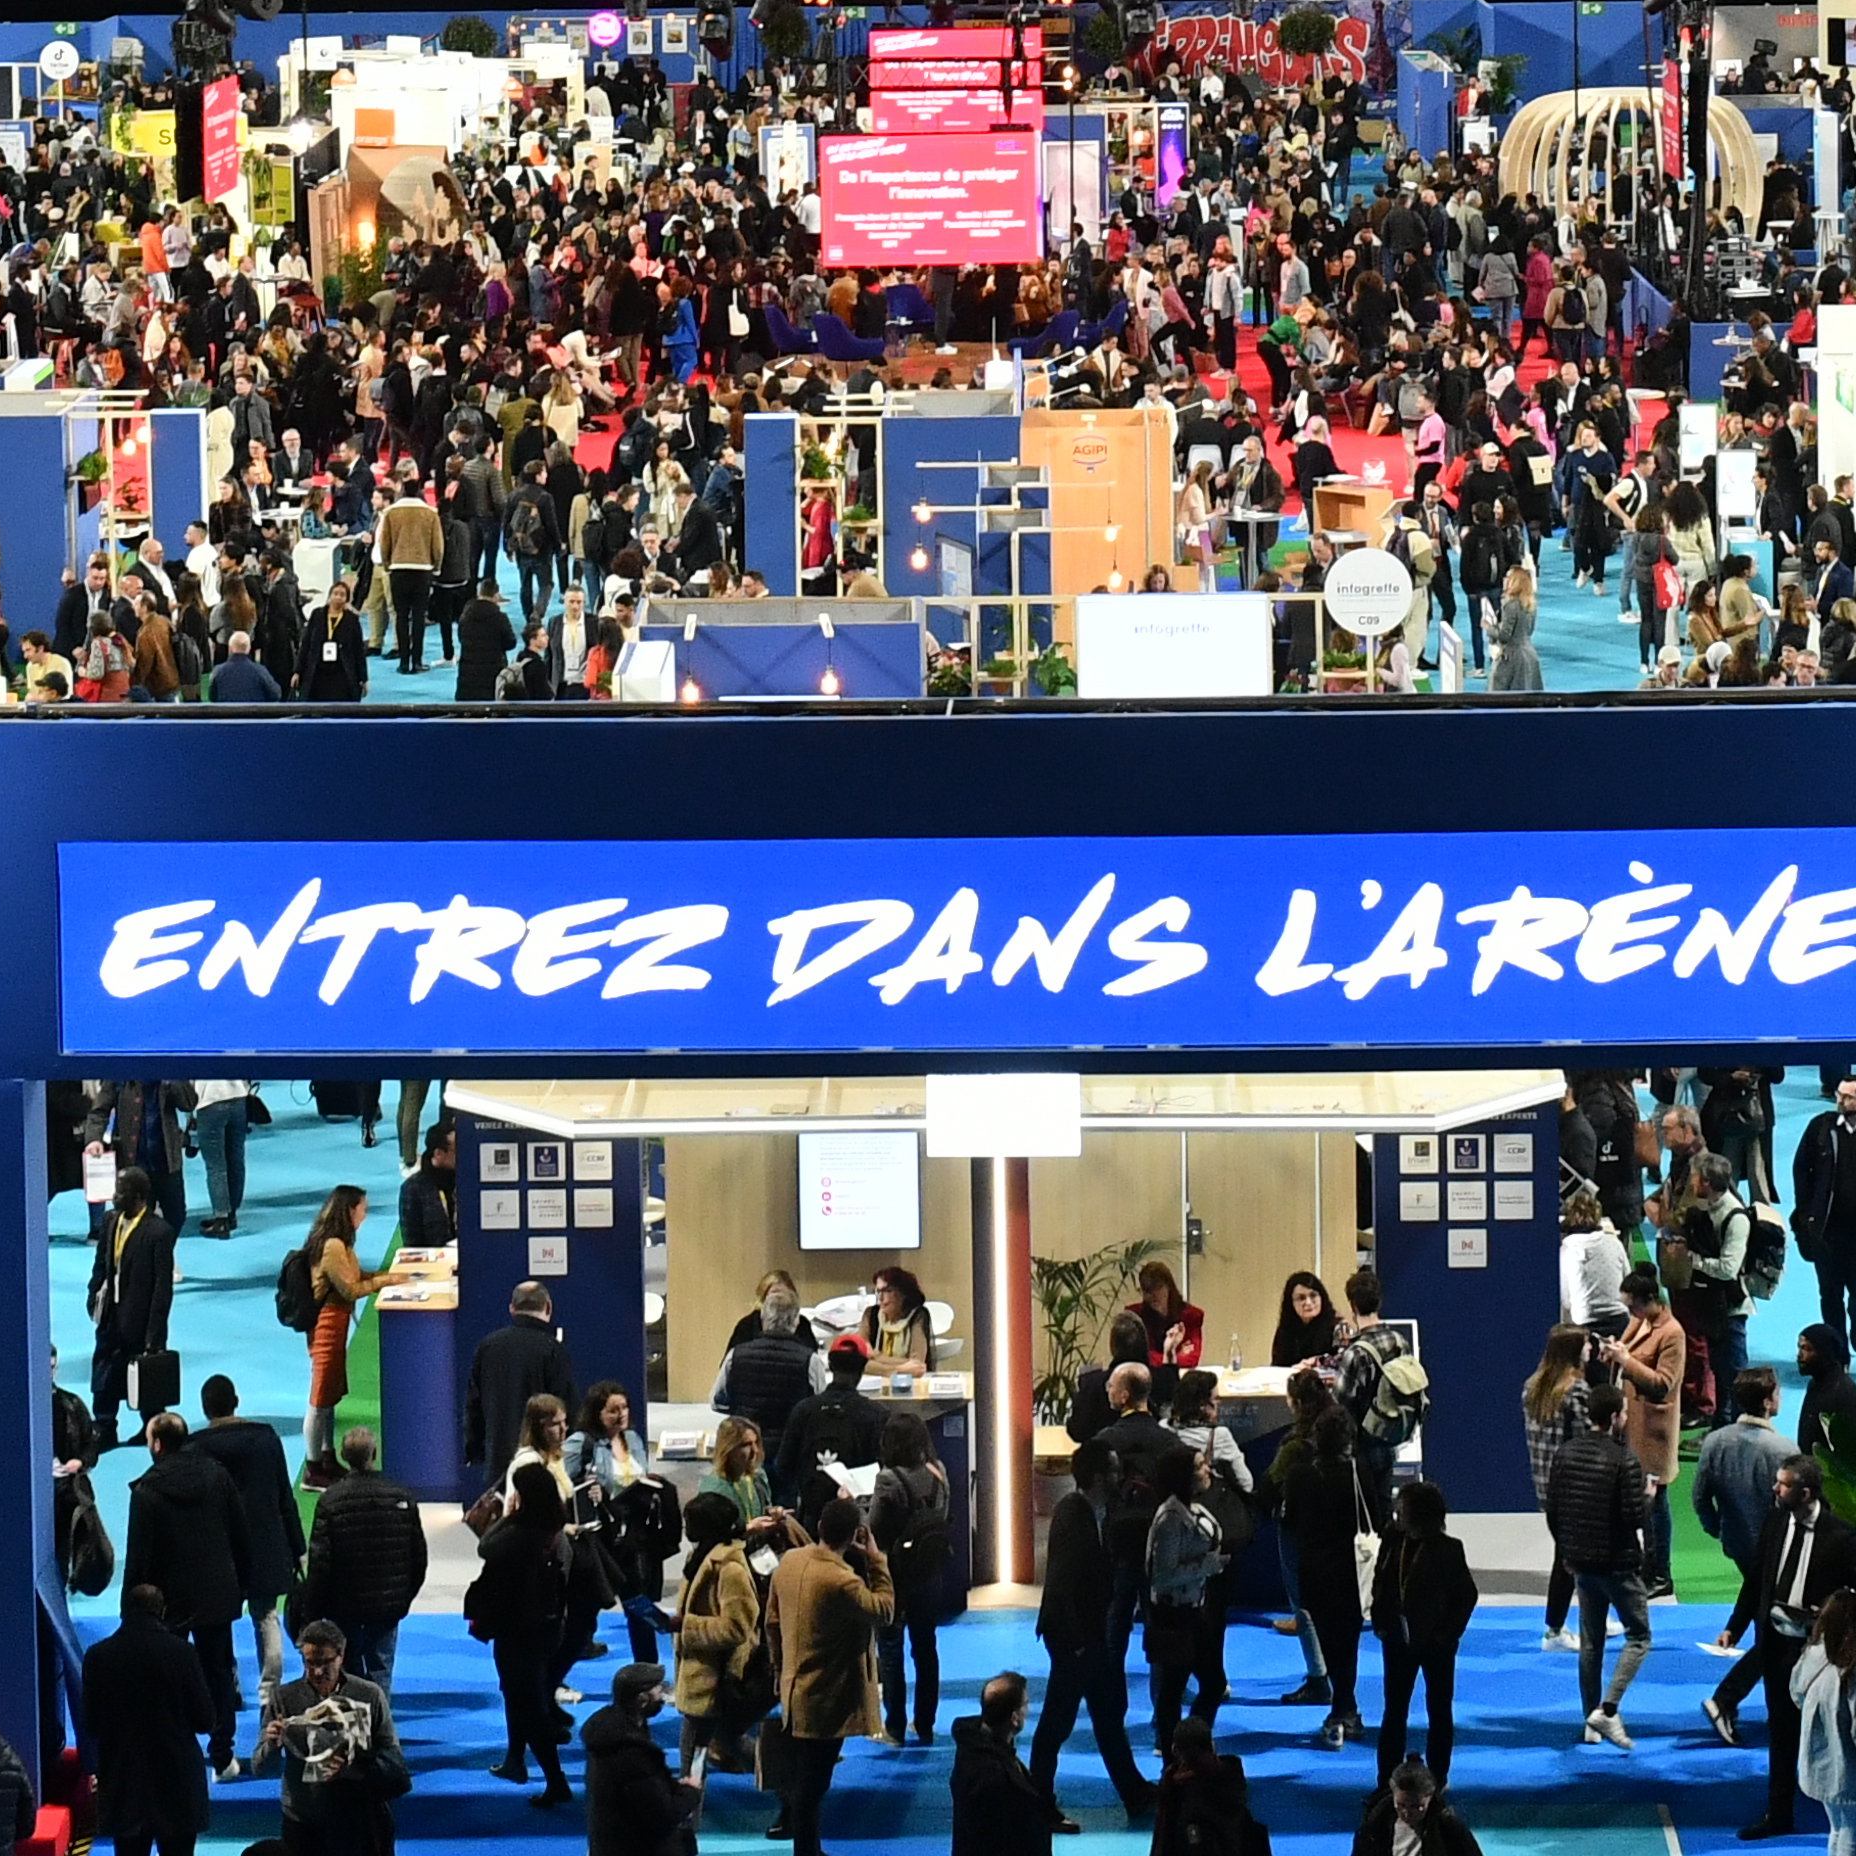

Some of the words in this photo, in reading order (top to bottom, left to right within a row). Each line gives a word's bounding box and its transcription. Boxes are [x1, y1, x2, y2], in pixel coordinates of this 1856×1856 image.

[839, 170, 858, 183] De
[1073, 443, 1108, 456] AGIPI
[1337, 582, 1401, 596] infogreffe
[1358, 615, 1380, 626] C09
[1134, 621, 1210, 638] infogreffe
[98, 874, 732, 1010] ENTREZ
[765, 871, 1207, 1014] DANS
